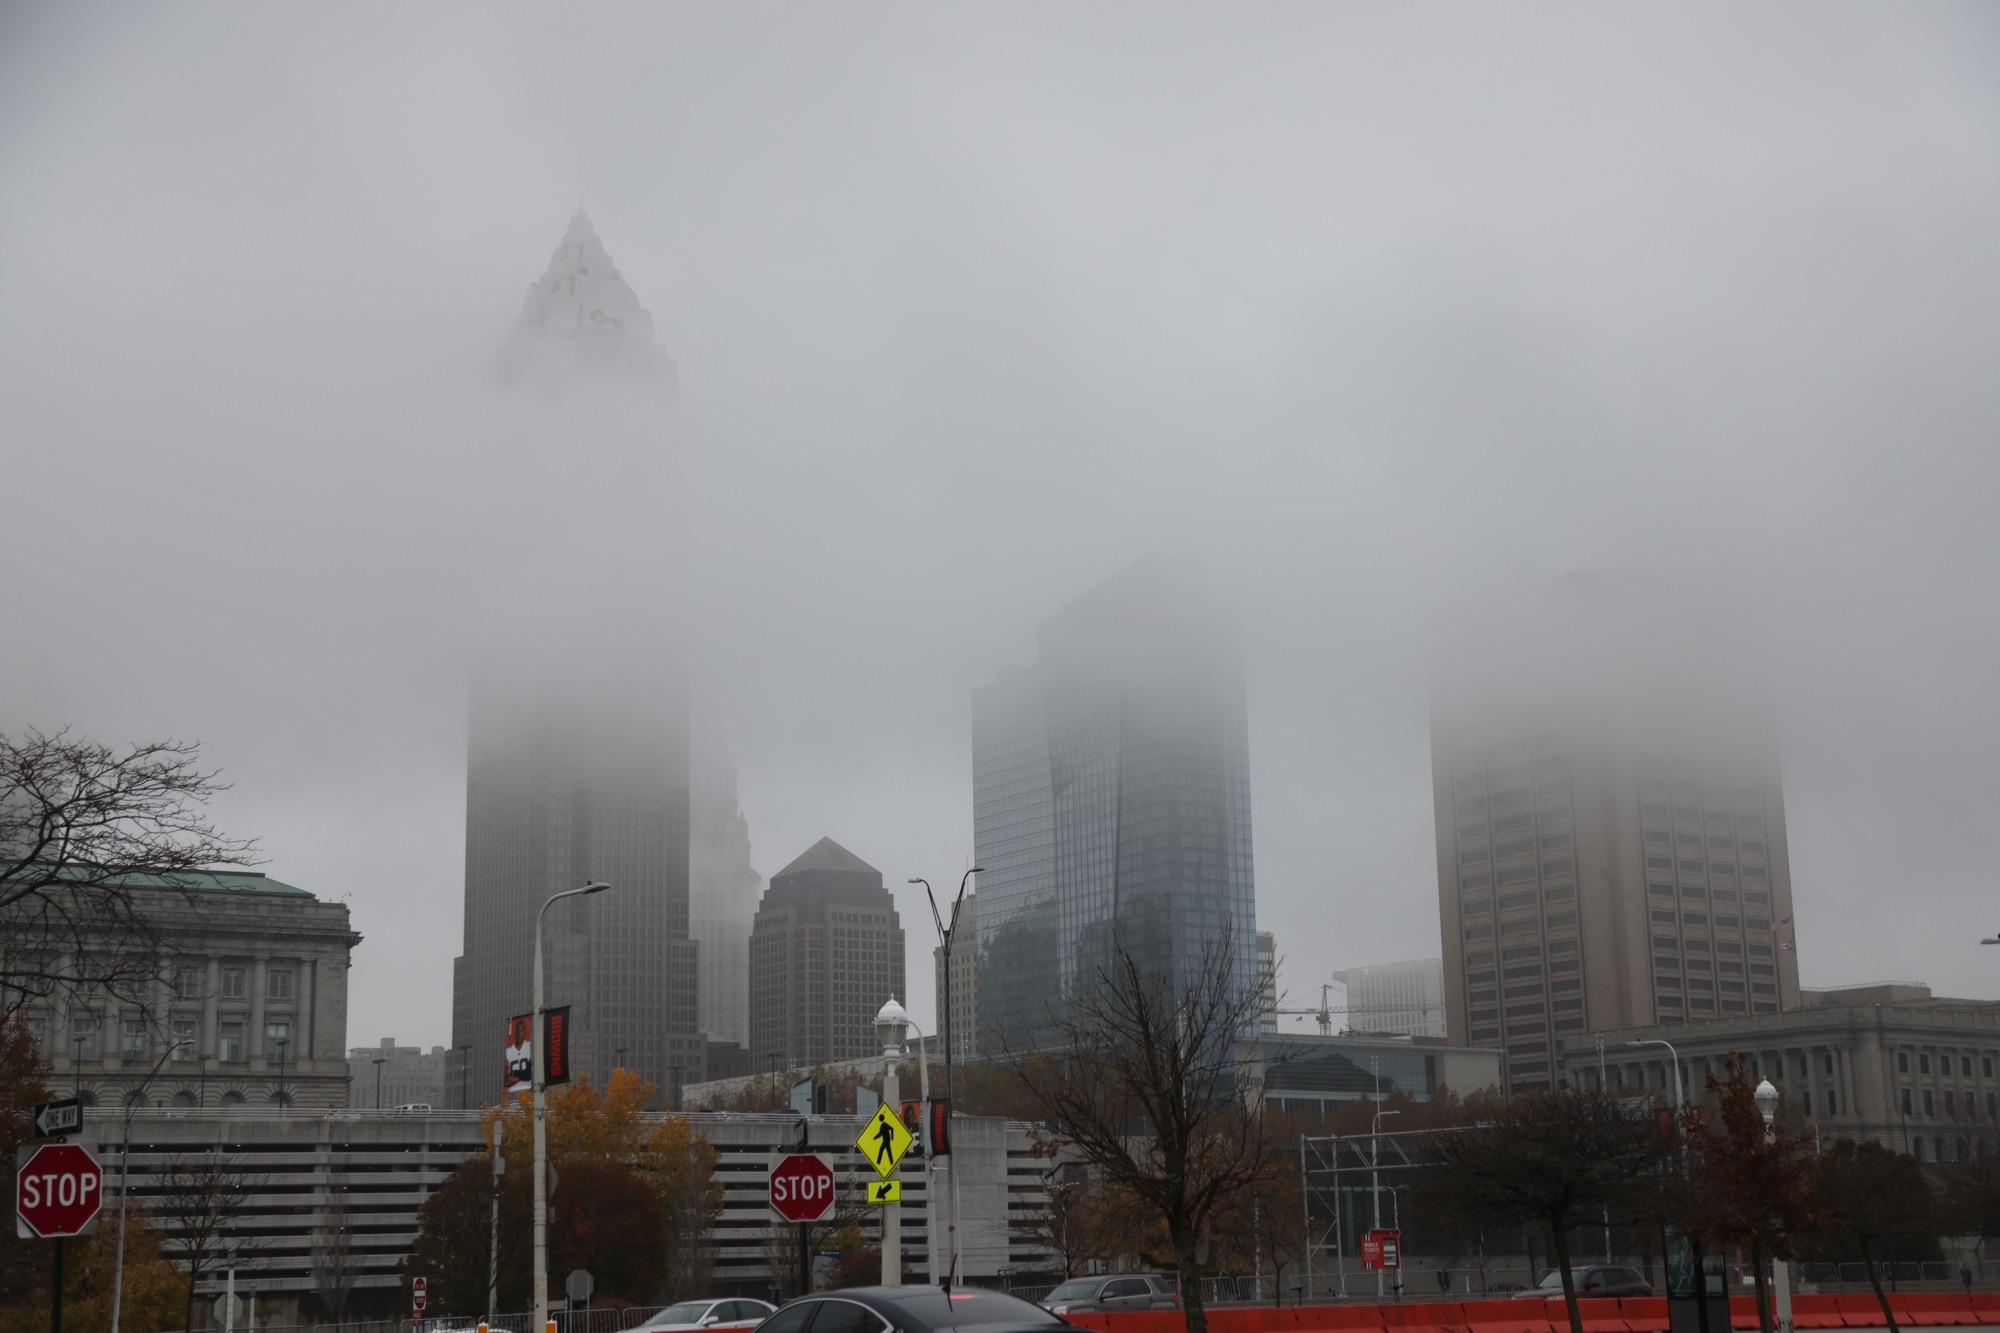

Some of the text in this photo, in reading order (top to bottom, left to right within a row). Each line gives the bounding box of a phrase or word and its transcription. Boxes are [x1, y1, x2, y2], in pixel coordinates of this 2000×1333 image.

[550, 1015, 562, 1078] BROWNS
[45, 1107, 76, 1129] ONE WAY
[935, 1103, 945, 1150] BROWNS
[23, 1173, 97, 1208] STOP
[774, 1175, 831, 1201] STOP
